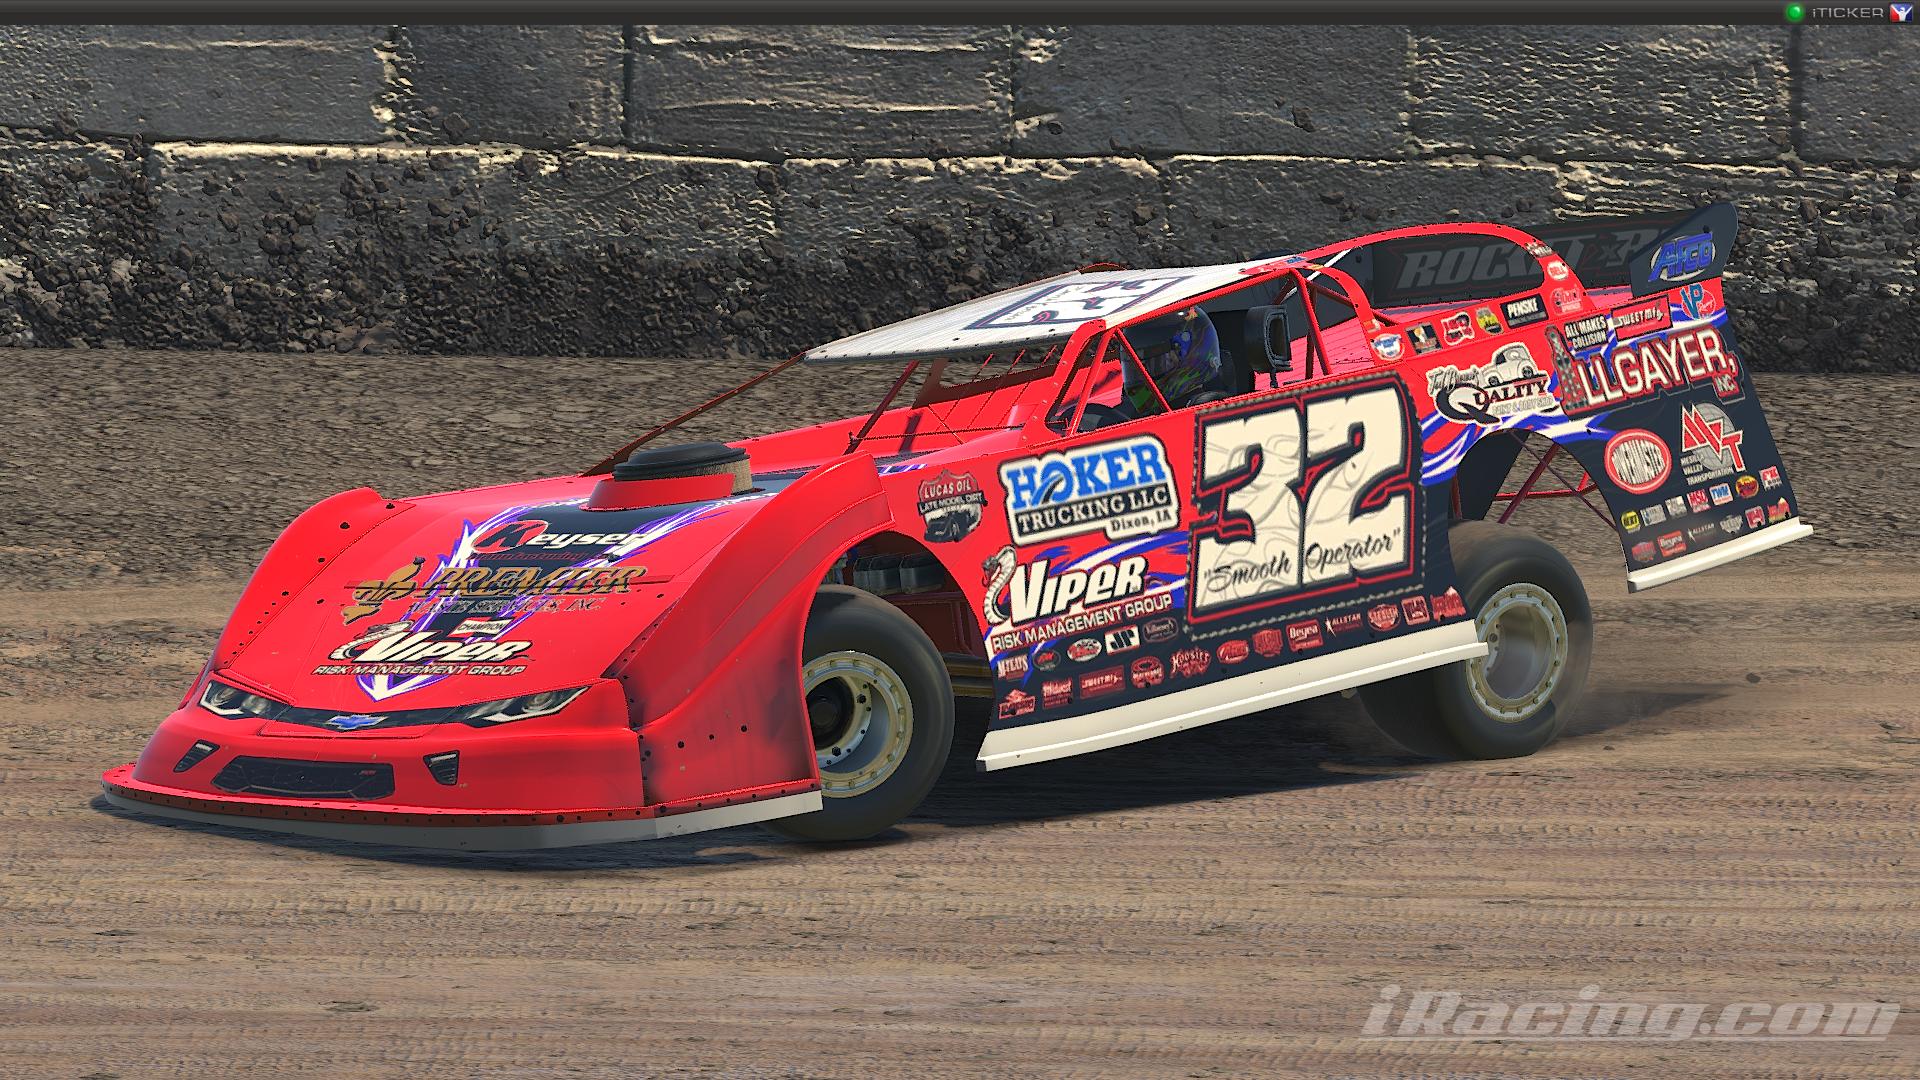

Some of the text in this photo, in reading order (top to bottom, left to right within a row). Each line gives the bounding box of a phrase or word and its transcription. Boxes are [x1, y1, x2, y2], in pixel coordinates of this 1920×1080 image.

[1648, 232, 1713, 282] AFCO
[1506, 297, 1539, 318] PENSKE
[1680, 282, 1704, 320] VP
[1565, 315, 1607, 338] ALL MAKES
[1572, 330, 1607, 350] COLLISION
[1436, 378, 1549, 423] QUALITY
[924, 479, 972, 499] LUCAS OIL
[1006, 443, 1166, 511] HOKER
[919, 500, 939, 514] LATE
[1018, 486, 1168, 534] TRUCKING LLC
[1195, 388, 1406, 608] 32
[1110, 508, 1172, 533] Dixon, IA
[413, 566, 648, 597] PREMIER
[1009, 555, 1149, 627] VIPER
[456, 619, 507, 633] CHAMPION
[992, 632, 1022, 652] RISK
[1024, 607, 1123, 644] MANAGEMENT
[1125, 593, 1173, 619] GROUP
[1331, 612, 1362, 626] ALLSTAR
[353, 631, 533, 662] VIPER
[311, 664, 528, 676] RISK MANAGEMENT GROUP
